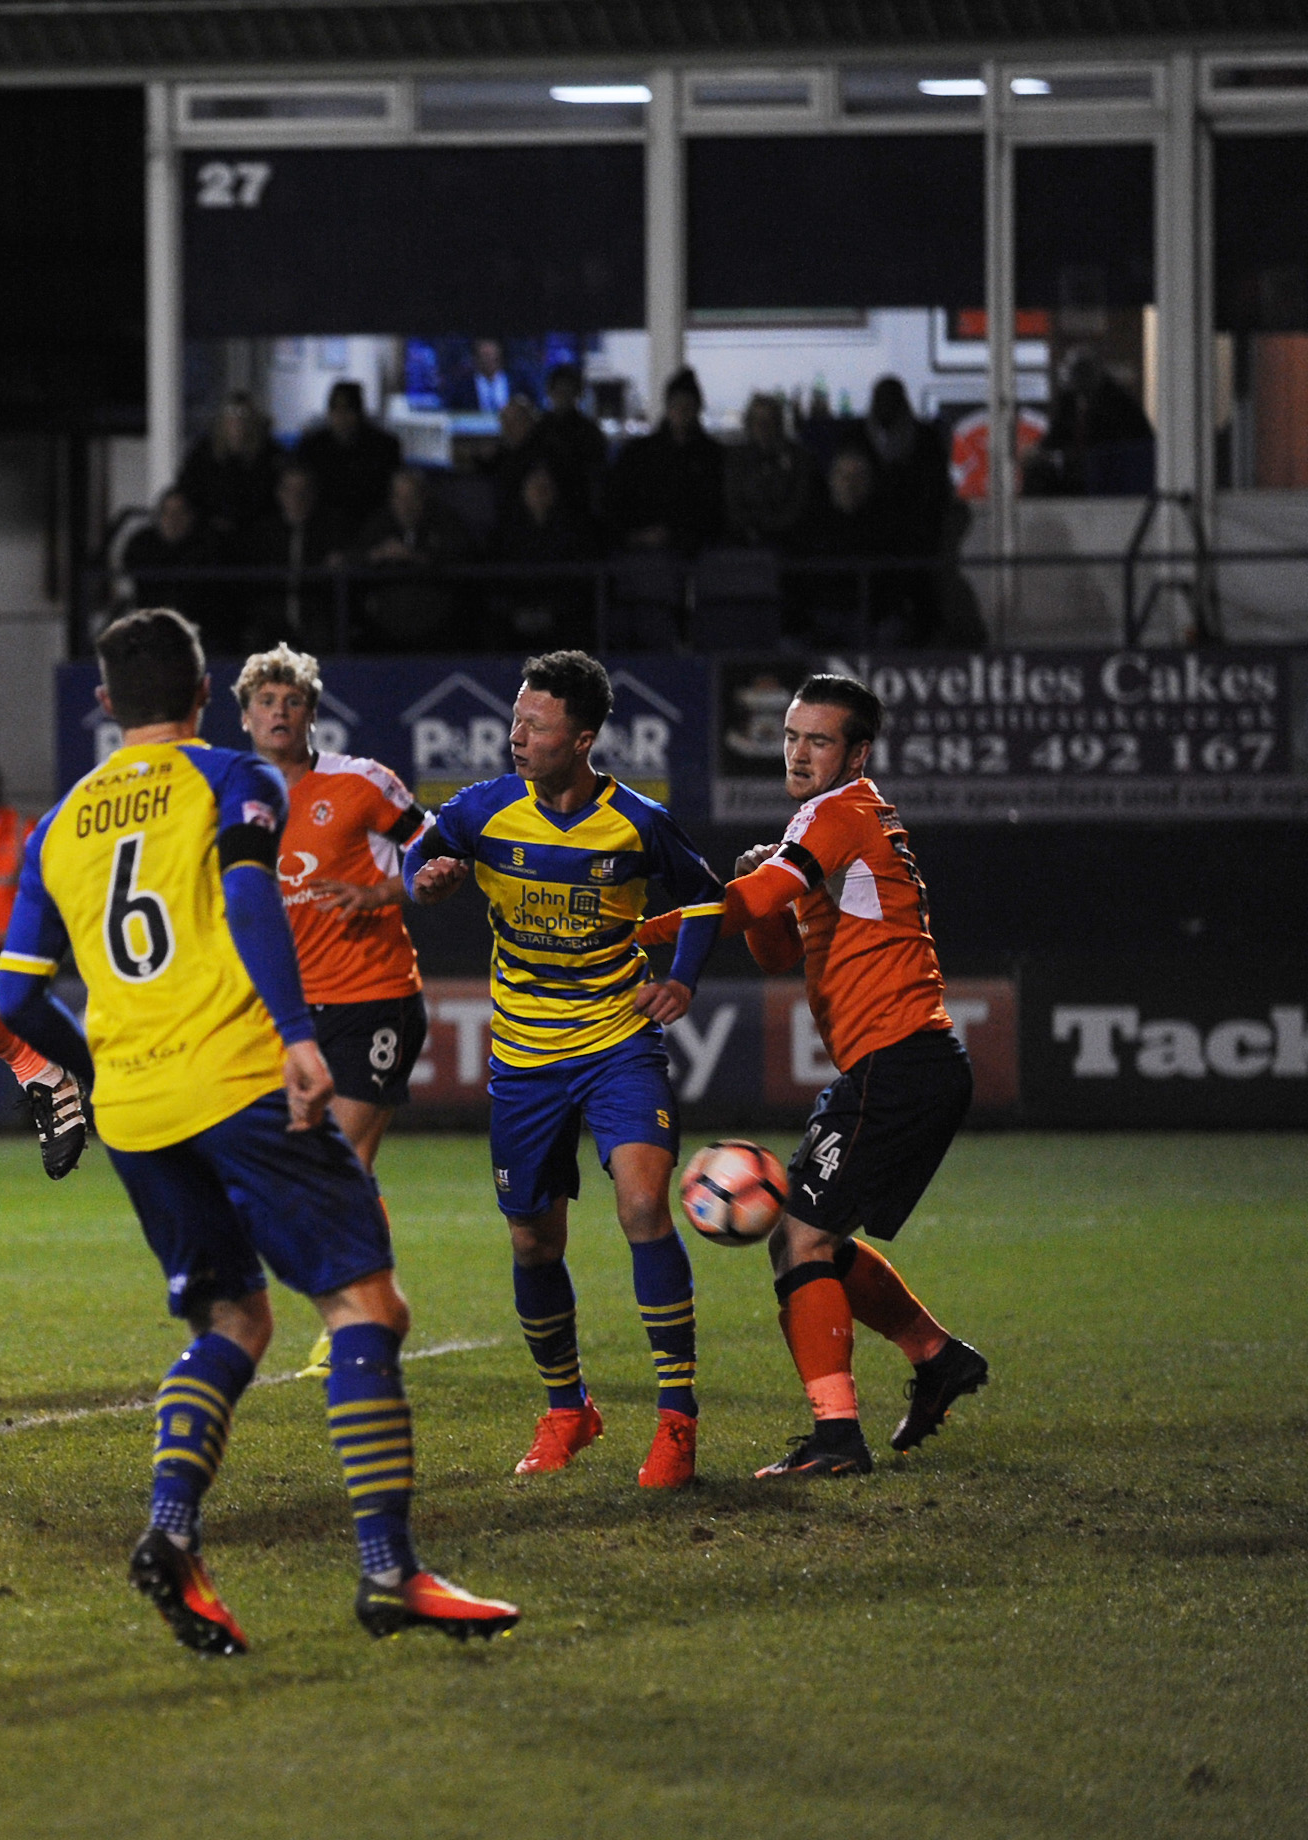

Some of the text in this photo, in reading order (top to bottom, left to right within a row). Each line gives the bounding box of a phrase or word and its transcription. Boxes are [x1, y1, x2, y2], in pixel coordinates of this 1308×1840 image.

[197, 162, 270, 207] 27
[1099, 652, 1278, 703] Cakes
[1031, 734, 1140, 773] 492
[1172, 733, 1275, 772] 167
[77, 784, 172, 839] GOUGH
[103, 831, 176, 984] 6
[520, 884, 565, 907] John
[512, 905, 603, 934] Shepherd
[515, 931, 552, 946] ESTATE
[369, 1027, 397, 1070] 8
